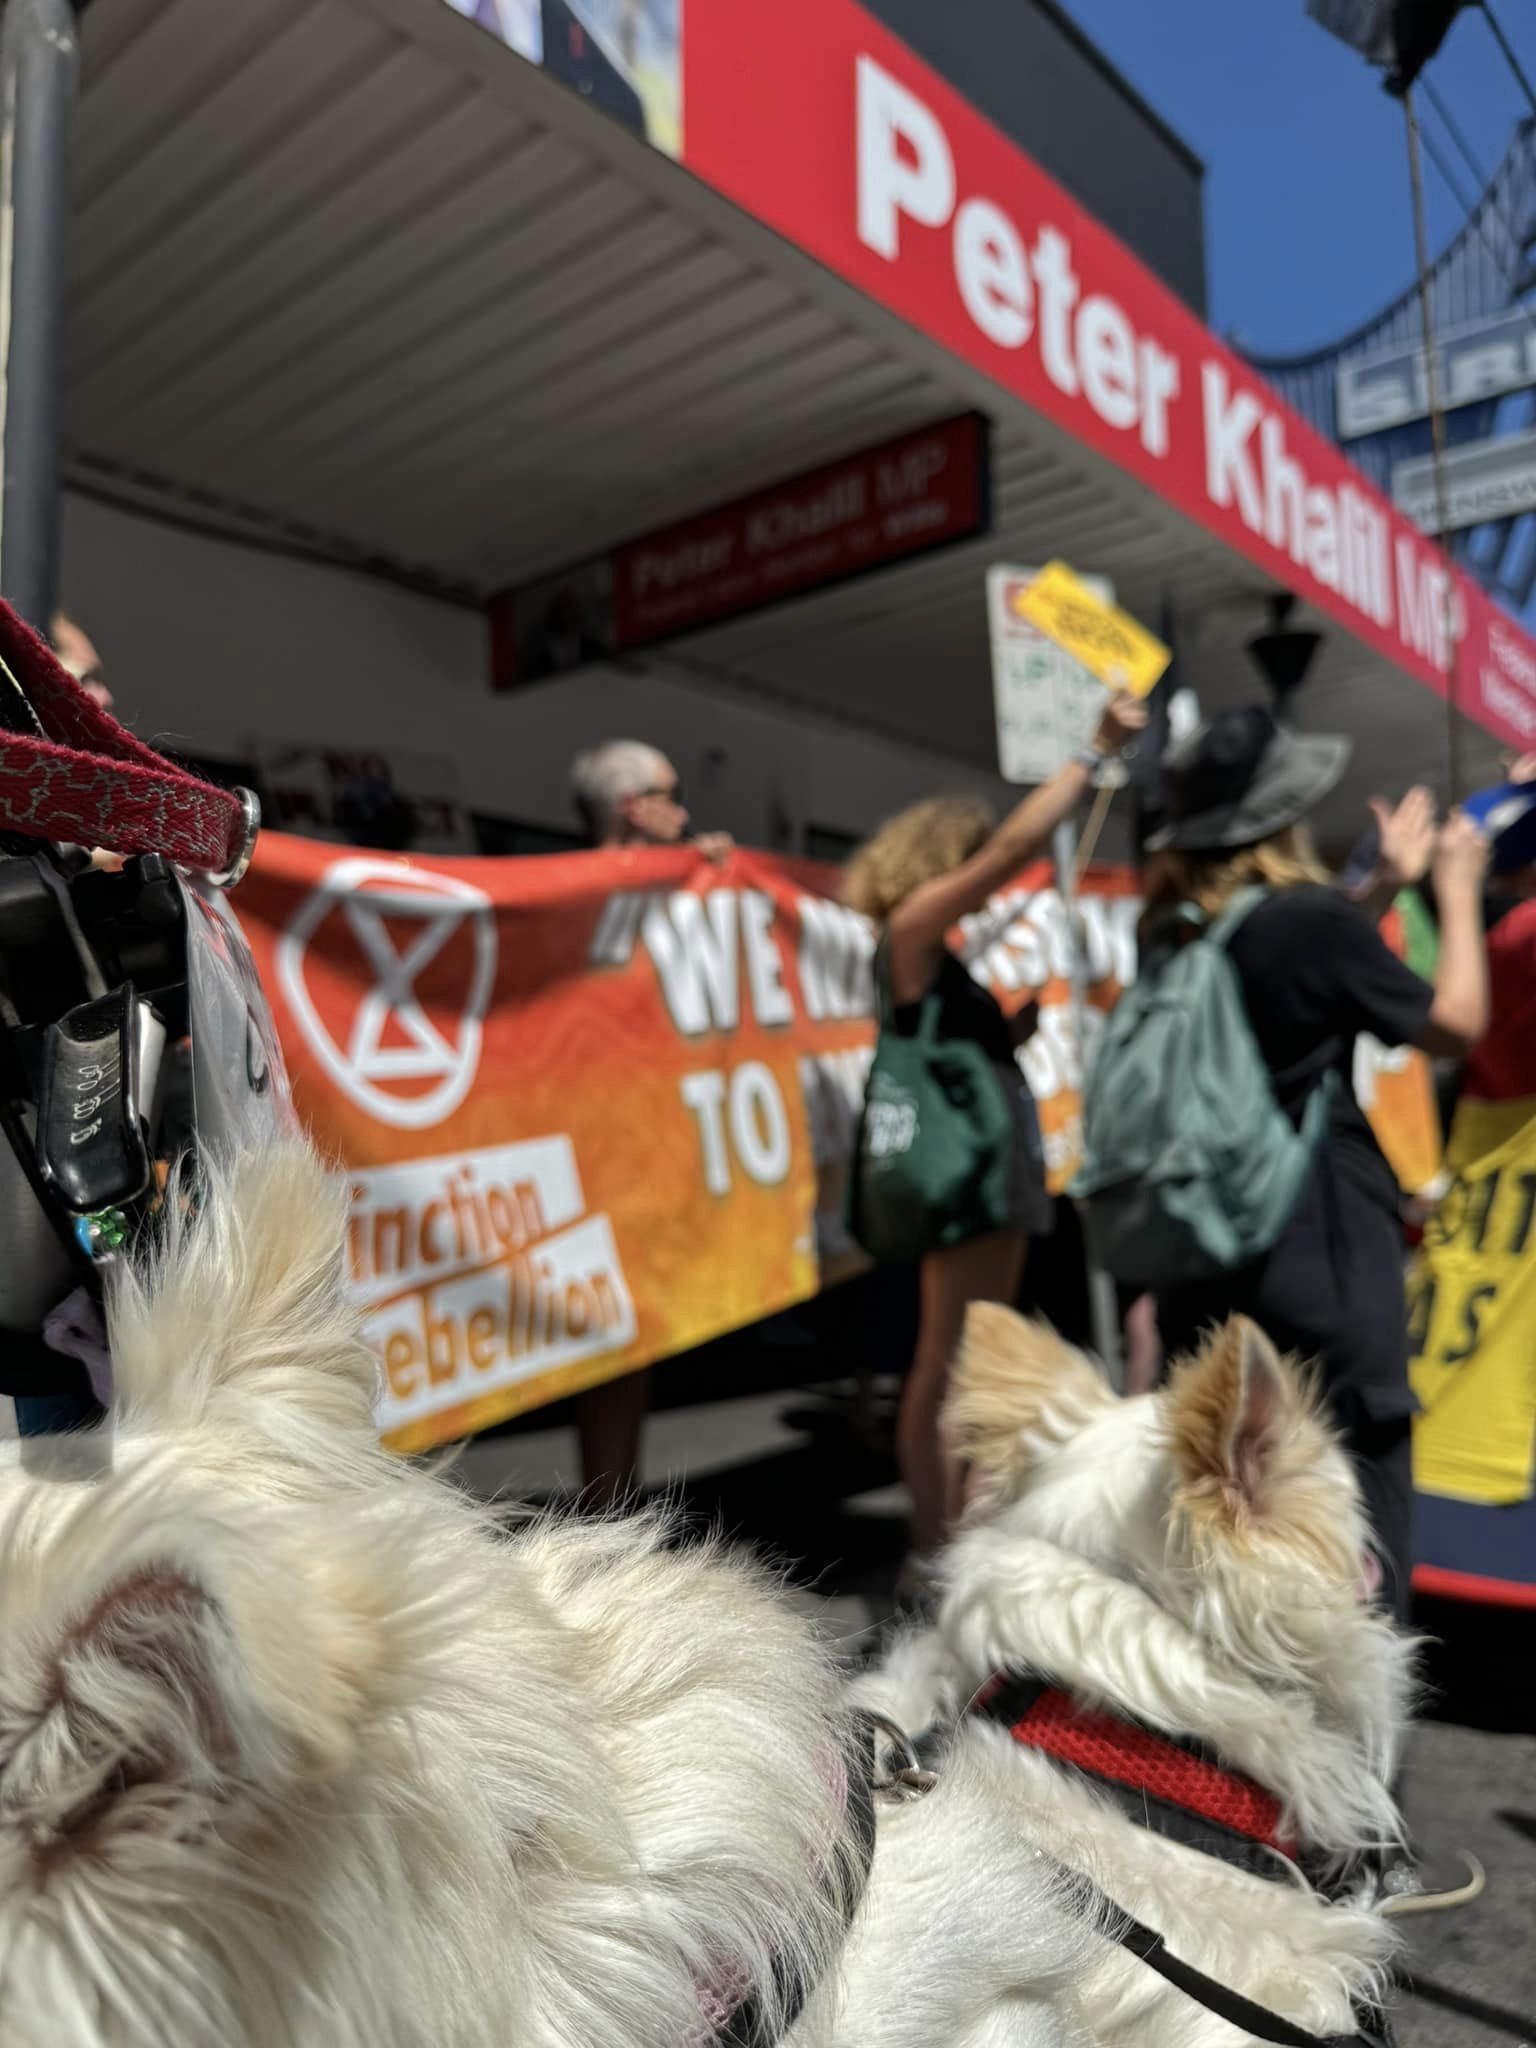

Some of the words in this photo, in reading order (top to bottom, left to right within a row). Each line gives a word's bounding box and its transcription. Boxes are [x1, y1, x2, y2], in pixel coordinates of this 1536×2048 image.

[857, 53, 1181, 460] Peter
[1201, 362, 1392, 628] Khalil
[1395, 535, 1467, 664] MP
[681, 1060, 791, 1196] TO
[348, 1162, 545, 1282] inction
[383, 1243, 622, 1402] ebellion
